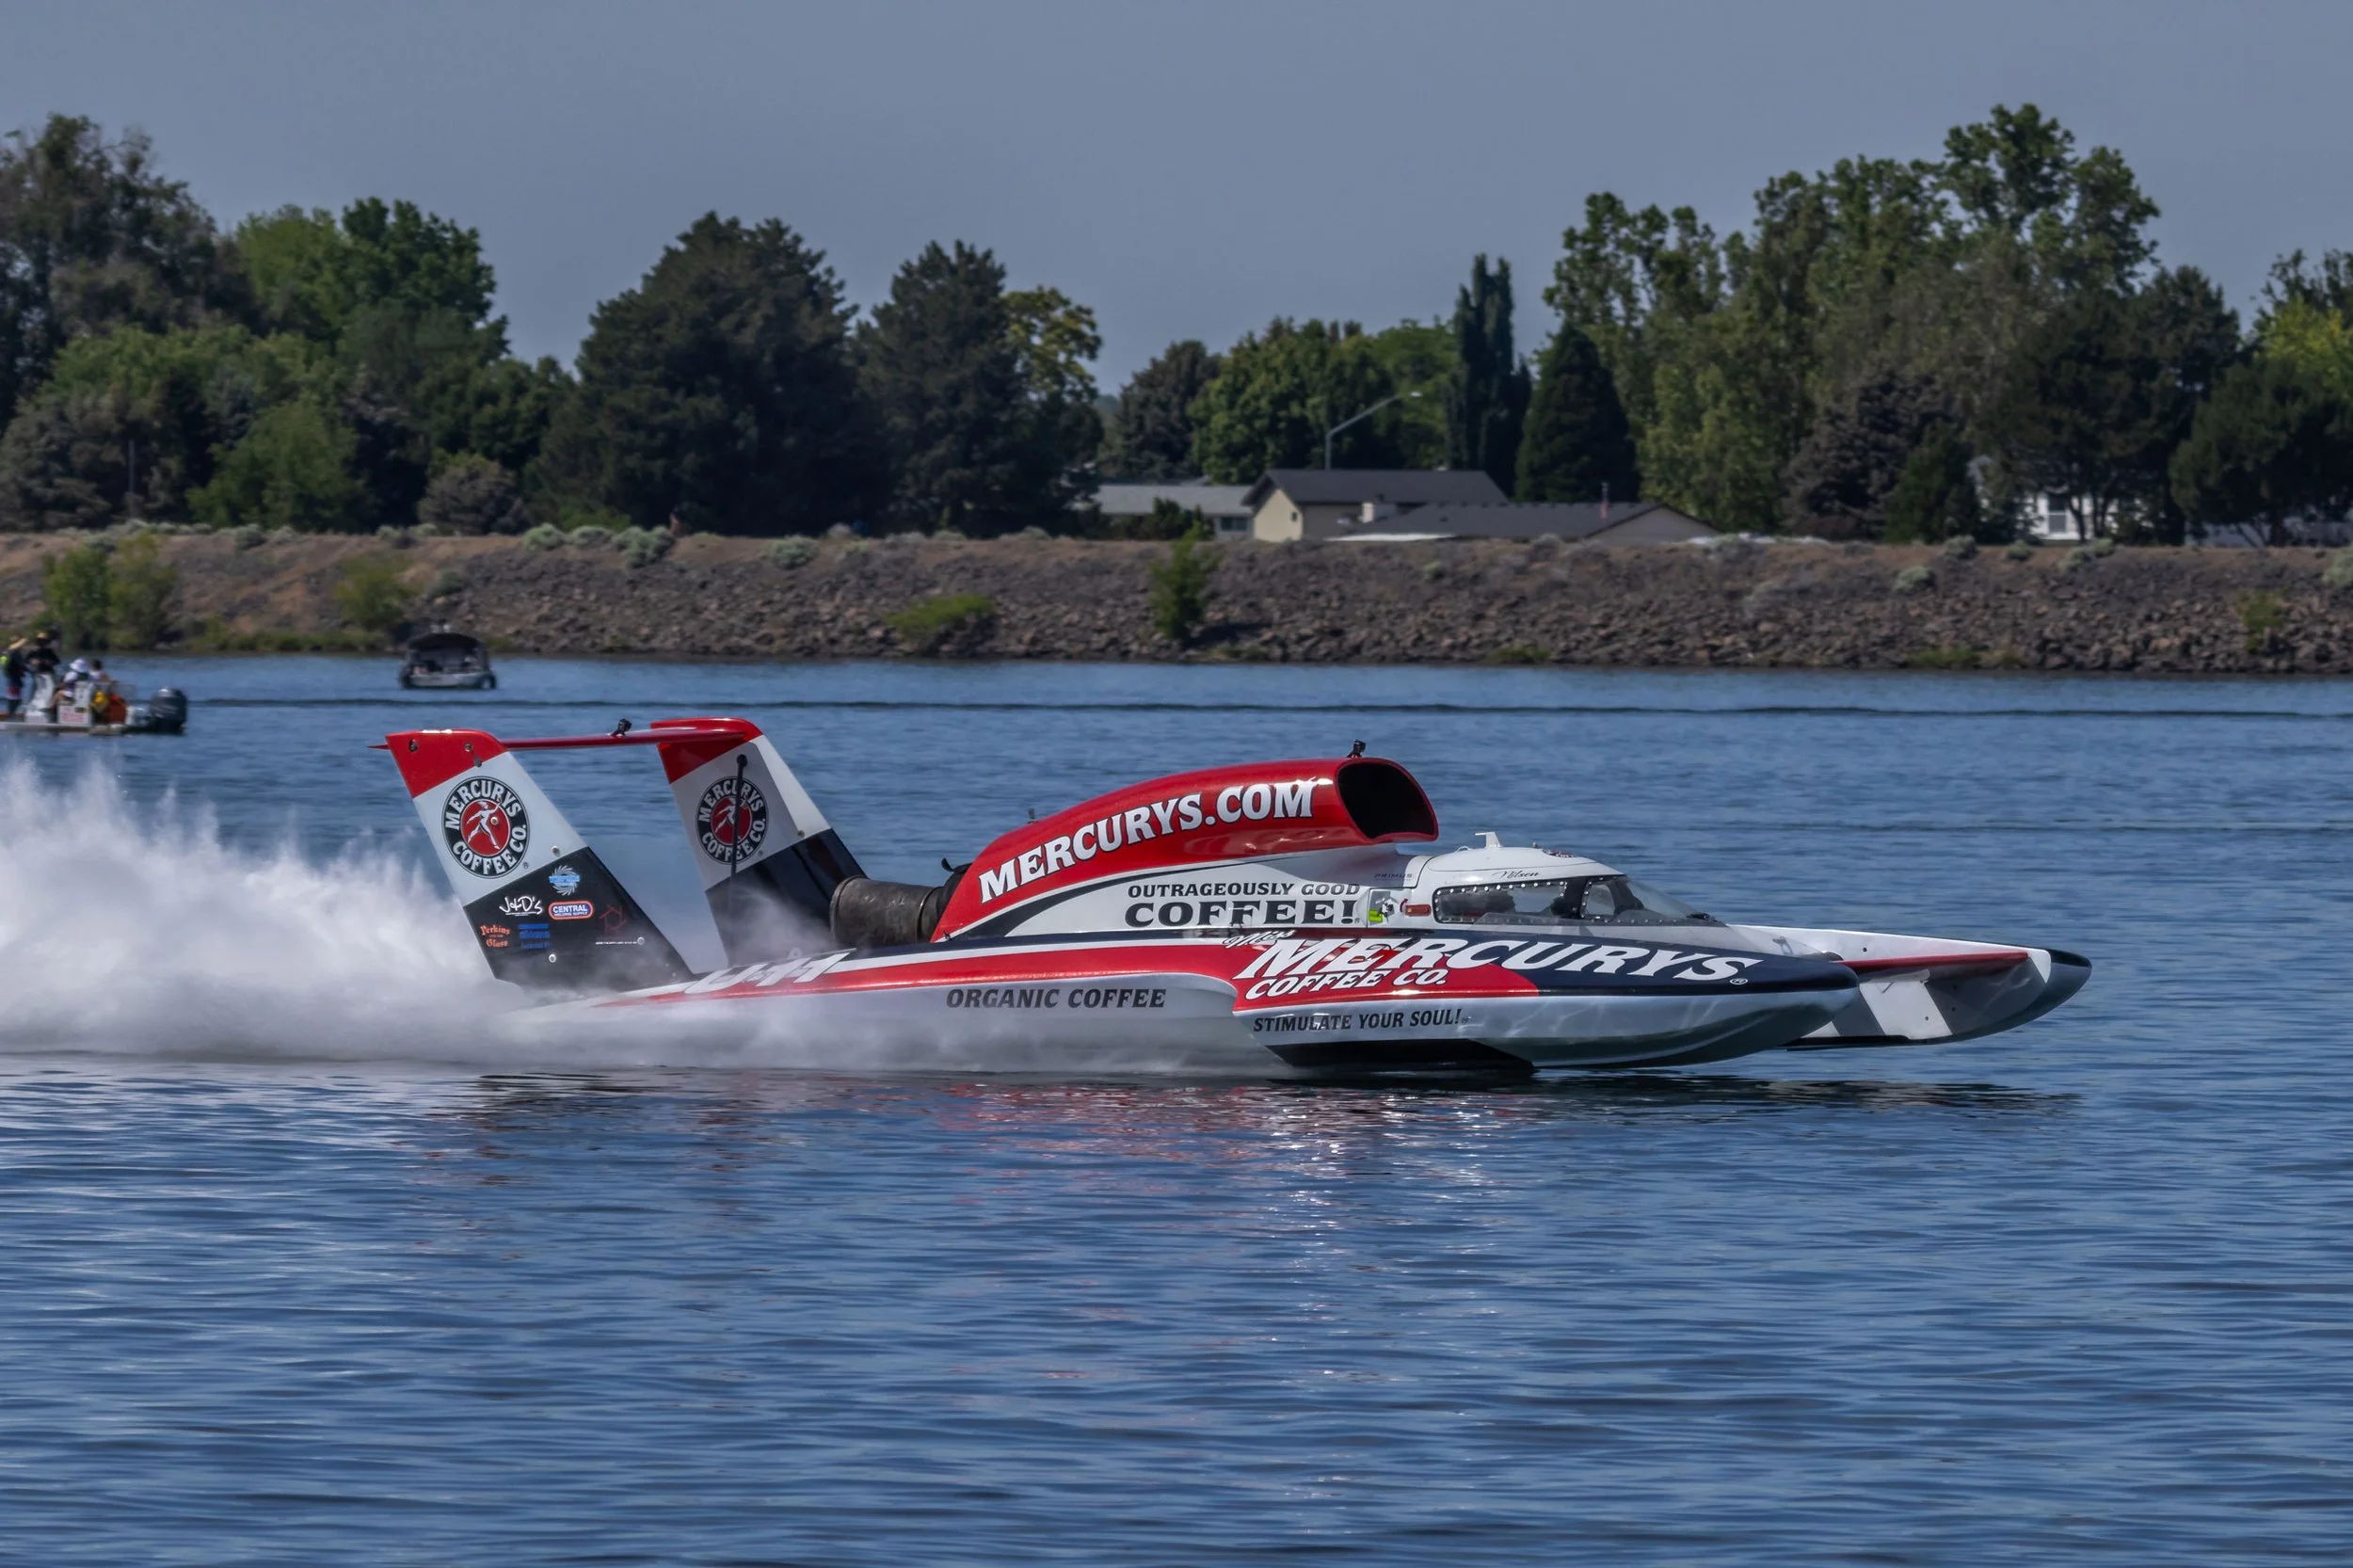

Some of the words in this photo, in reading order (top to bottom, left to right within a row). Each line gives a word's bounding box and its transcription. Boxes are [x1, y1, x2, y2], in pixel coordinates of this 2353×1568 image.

[445, 780, 521, 830] MERCURYS
[749, 818, 766, 842] CO.
[978, 782, 1315, 904] MERCURYS.COM
[453, 841, 517, 874] COFFEE
[509, 824, 527, 853] CO.
[1128, 883, 1294, 898] OUTRAGEOUSLY
[1301, 883, 1361, 895] GOOD
[552, 904, 588, 913] CENTRAL
[1125, 900, 1358, 928] COFFEE!
[1232, 938, 1764, 981] MERCURYS
[946, 988, 1060, 1008] ORGANIC
[1067, 988, 1167, 1008] COFFEE
[1245, 970, 1389, 1000] COFFEE
[1392, 969, 1449, 985] CO.
[1253, 1015, 1352, 1032] STIMULATE
[1358, 1012, 1403, 1029] YOUR
[1409, 1009, 1462, 1027] SOUL!
